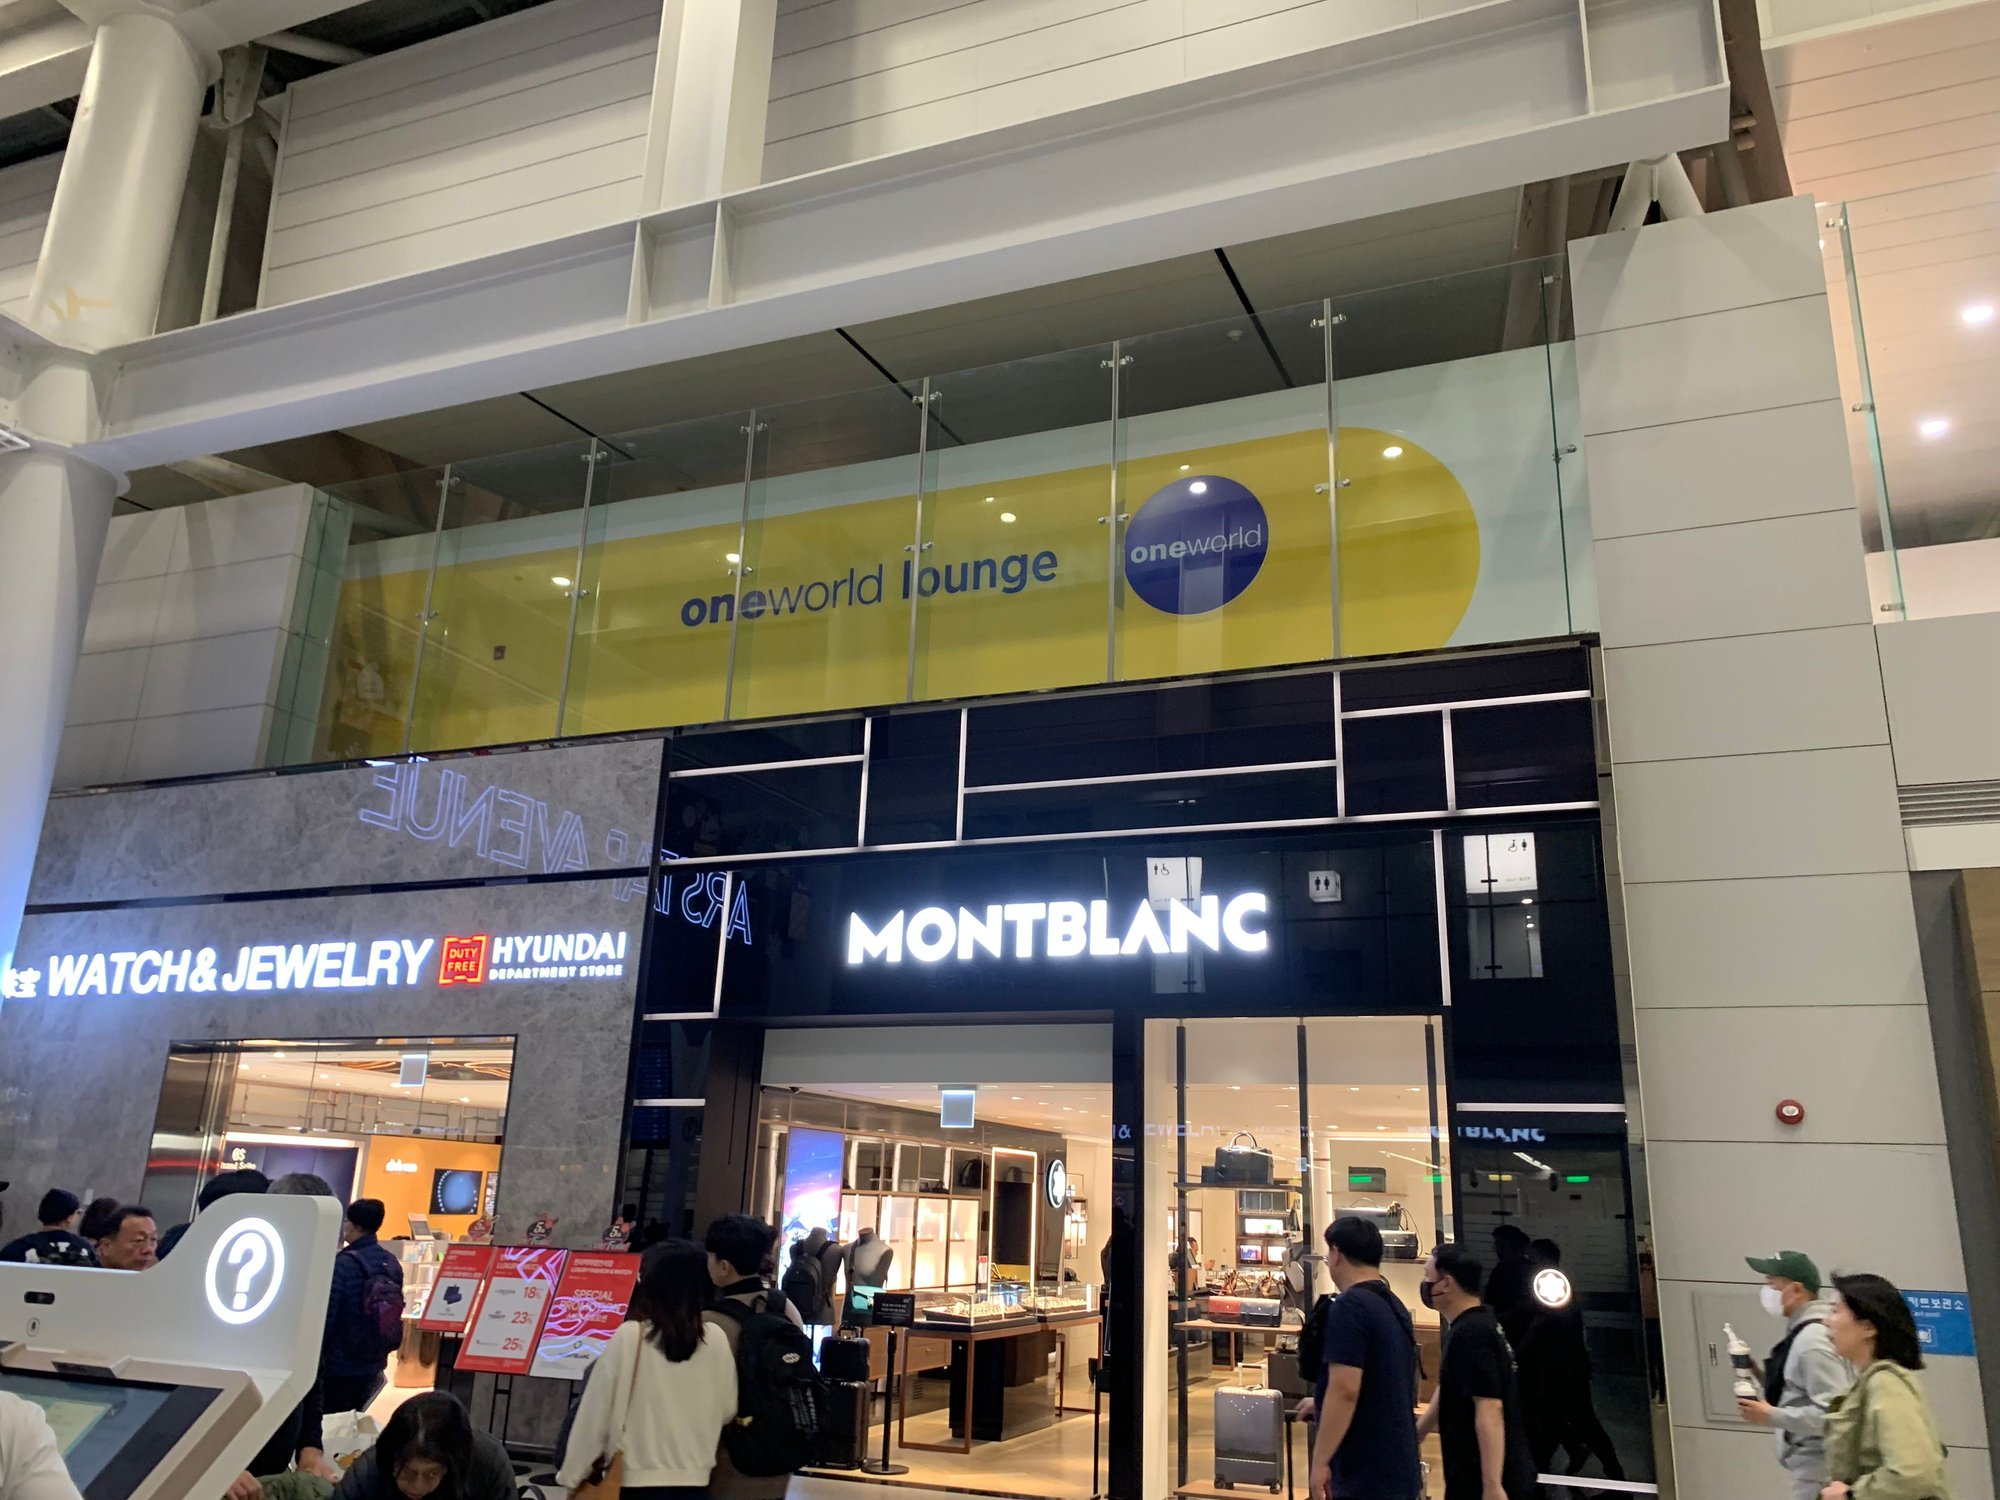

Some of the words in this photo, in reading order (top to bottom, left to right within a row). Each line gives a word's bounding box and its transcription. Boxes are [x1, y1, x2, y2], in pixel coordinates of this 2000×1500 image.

[1130, 524, 1262, 565] oneworld
[681, 564, 883, 628] oneworld
[902, 549, 1059, 600] lounge
[847, 891, 1268, 966] MONTBLANC
[449, 946, 479, 959] DUTY
[491, 930, 627, 964] HYUNDAI
[447, 960, 477, 972] FREE
[489, 966, 577, 980] DEPARTMENT
[579, 964, 623, 977] STORE
[573, 1288, 614, 1301] SPECIAL
